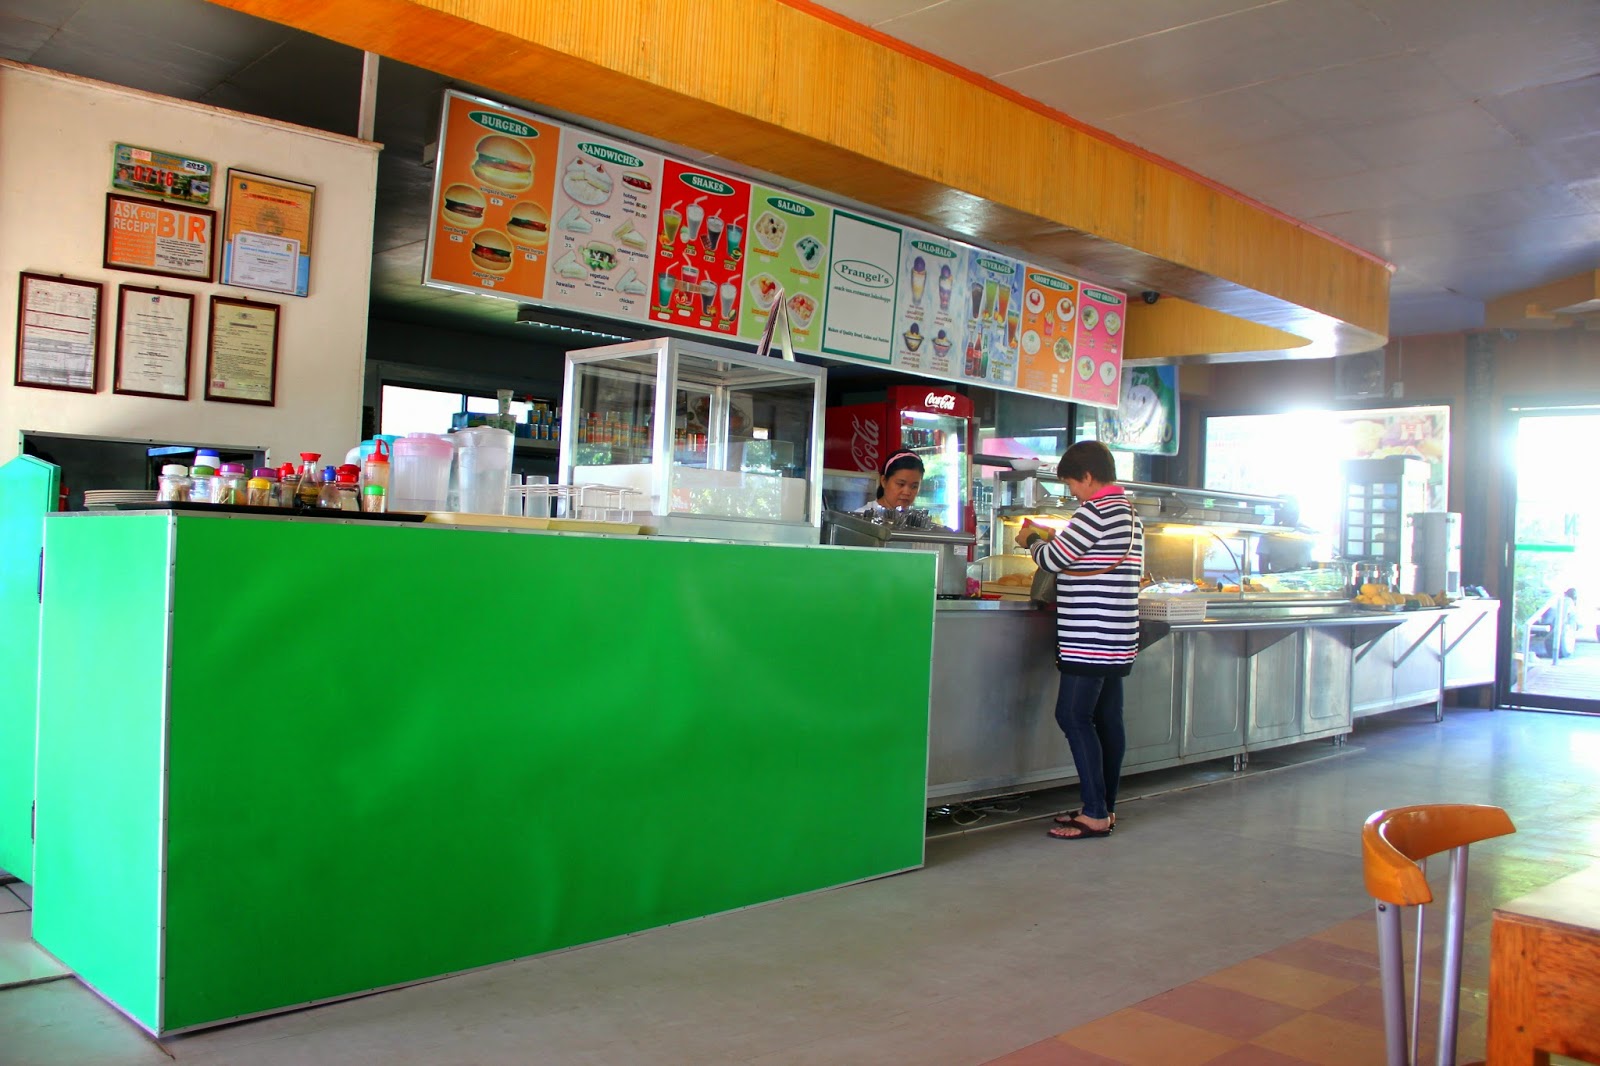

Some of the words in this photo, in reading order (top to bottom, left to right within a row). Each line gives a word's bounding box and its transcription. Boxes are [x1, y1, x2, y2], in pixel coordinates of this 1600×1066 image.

[481, 114, 528, 136] BURGERS
[582, 143, 640, 167] SANDWICHES
[134, 165, 174, 186] 0716
[692, 176, 724, 192] SHAKES
[114, 202, 139, 220] ASK
[141, 210, 156, 220] FOR
[777, 200, 806, 214] SALADS
[114, 217, 156, 234] RECEIPT
[157, 210, 206, 243] BIR
[917, 242, 952, 258] HALO-HALO
[841, 264, 890, 284] Prangel's
[980, 259, 1011, 274] BEVERAGES
[1033, 275, 1050, 285] SHORT
[1050, 278, 1070, 290] ORDERS
[1087, 290, 1101, 300] SHORT
[1102, 293, 1118, 304] ORDERS
[925, 392, 956, 410] Coca-Cola
